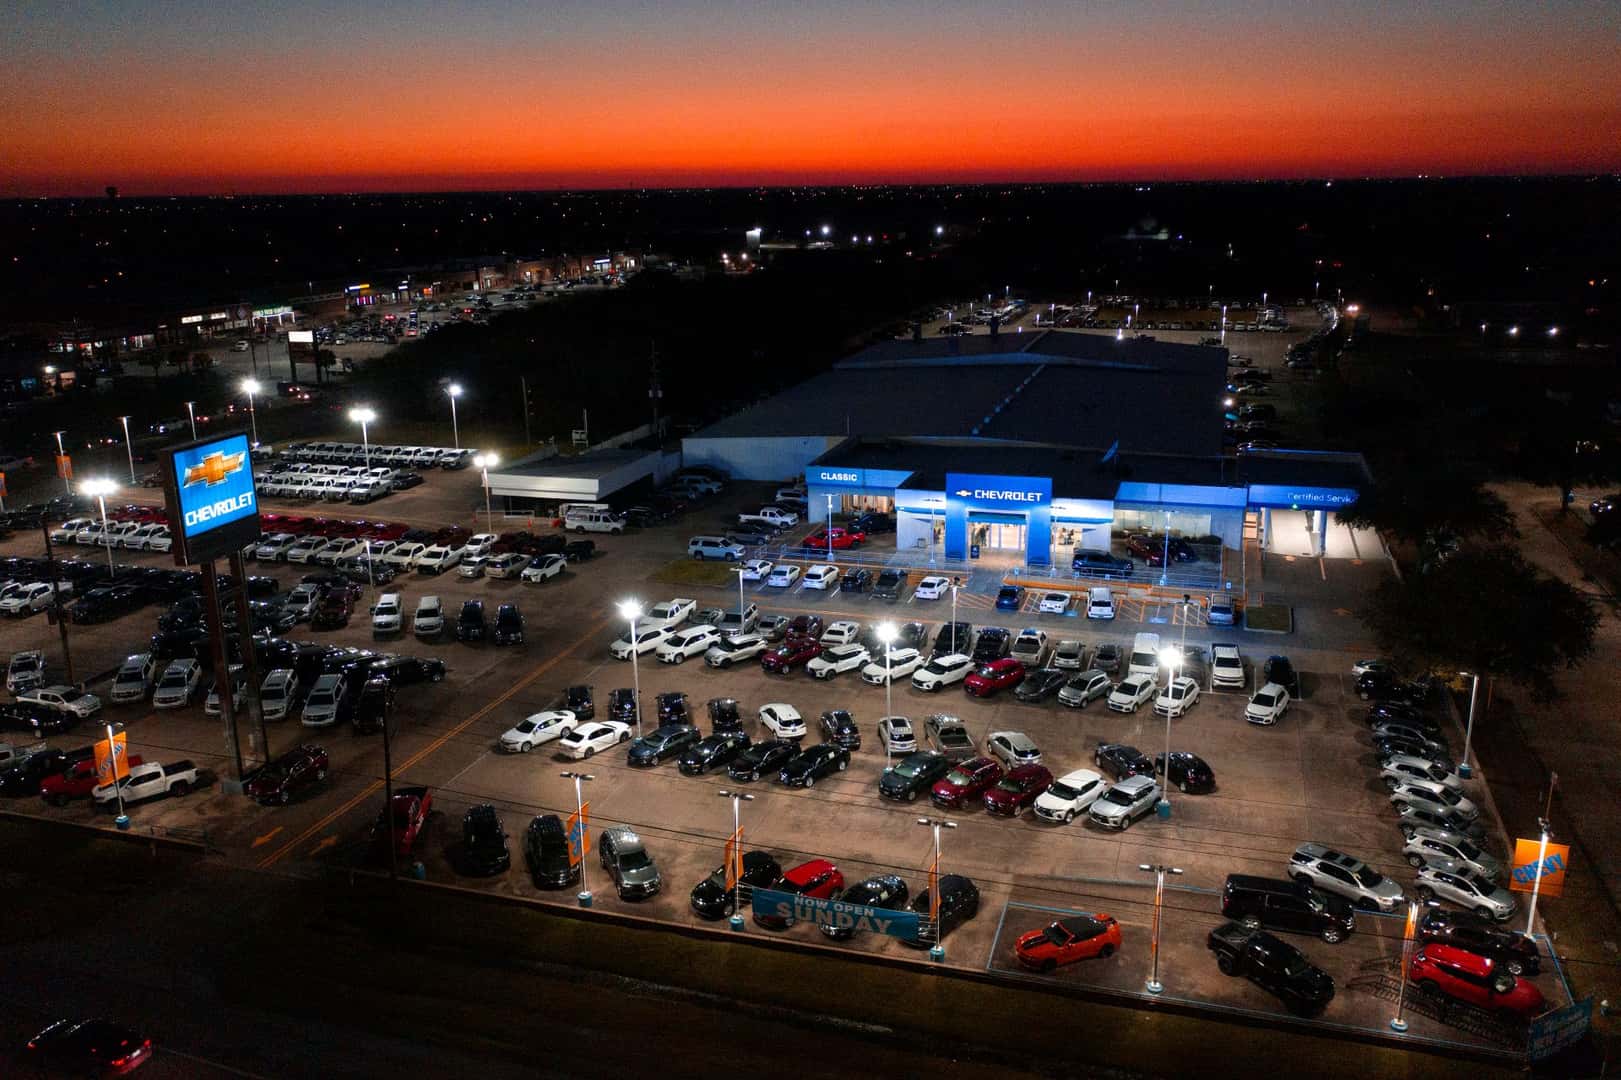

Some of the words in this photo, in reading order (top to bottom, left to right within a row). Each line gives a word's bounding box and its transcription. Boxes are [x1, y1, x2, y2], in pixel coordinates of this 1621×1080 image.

[820, 472, 858, 482] CLASSIC
[974, 489, 1043, 502] CHEVROLET
[1287, 492, 1324, 502] Certified
[184, 492, 254, 527] CHEVROLET
[794, 896, 829, 910] NOW
[834, 903, 875, 917] OPEN
[776, 902, 893, 933] SUNDAY
